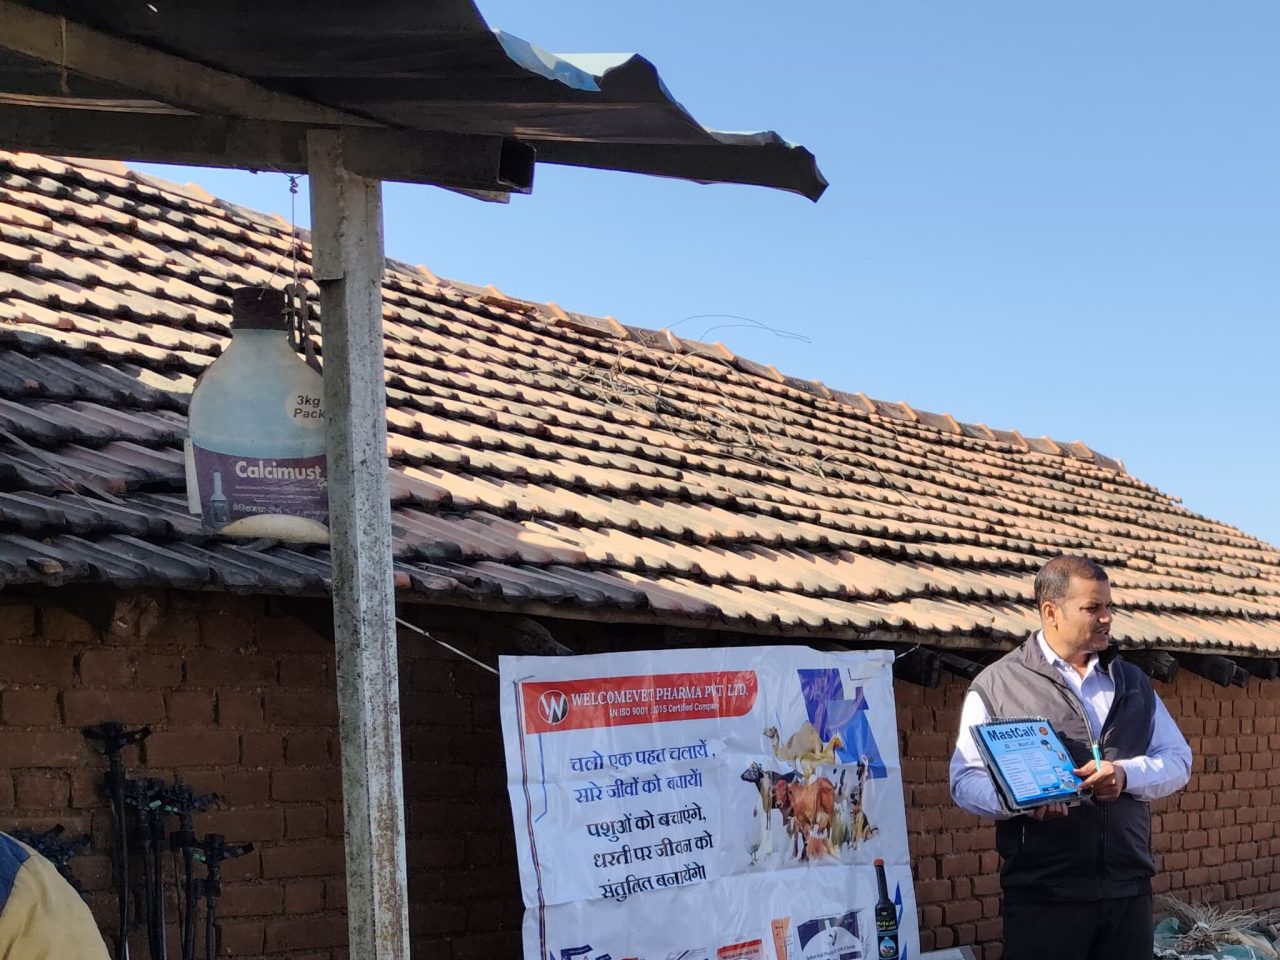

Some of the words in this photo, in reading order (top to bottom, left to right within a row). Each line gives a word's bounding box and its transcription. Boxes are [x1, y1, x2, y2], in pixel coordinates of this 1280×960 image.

[296, 395, 321, 408] 3kg
[293, 408, 325, 419] Pack
[235, 460, 322, 480] Calcimust
[571, 690, 654, 706] WELCOMEVET
[656, 686, 702, 701] PHARMA
[727, 682, 748, 697] LTD.
[619, 707, 631, 717] ISO
[632, 706, 649, 716] 9001
[668, 703, 694, 713] Certified
[986, 725, 1037, 742] MastCalf
[570, 750, 605, 772] चलो
[608, 752, 633, 769] एक
[574, 781, 603, 803] सारे
[606, 776, 639, 799] जीवों
[642, 773, 662, 794] को
[586, 812, 633, 842] पशुओं
[634, 809, 656, 831] को
[593, 844, 633, 868] धरती
[633, 845, 654, 861] पर
[654, 837, 693, 857] जीवन
[693, 829, 714, 850] को
